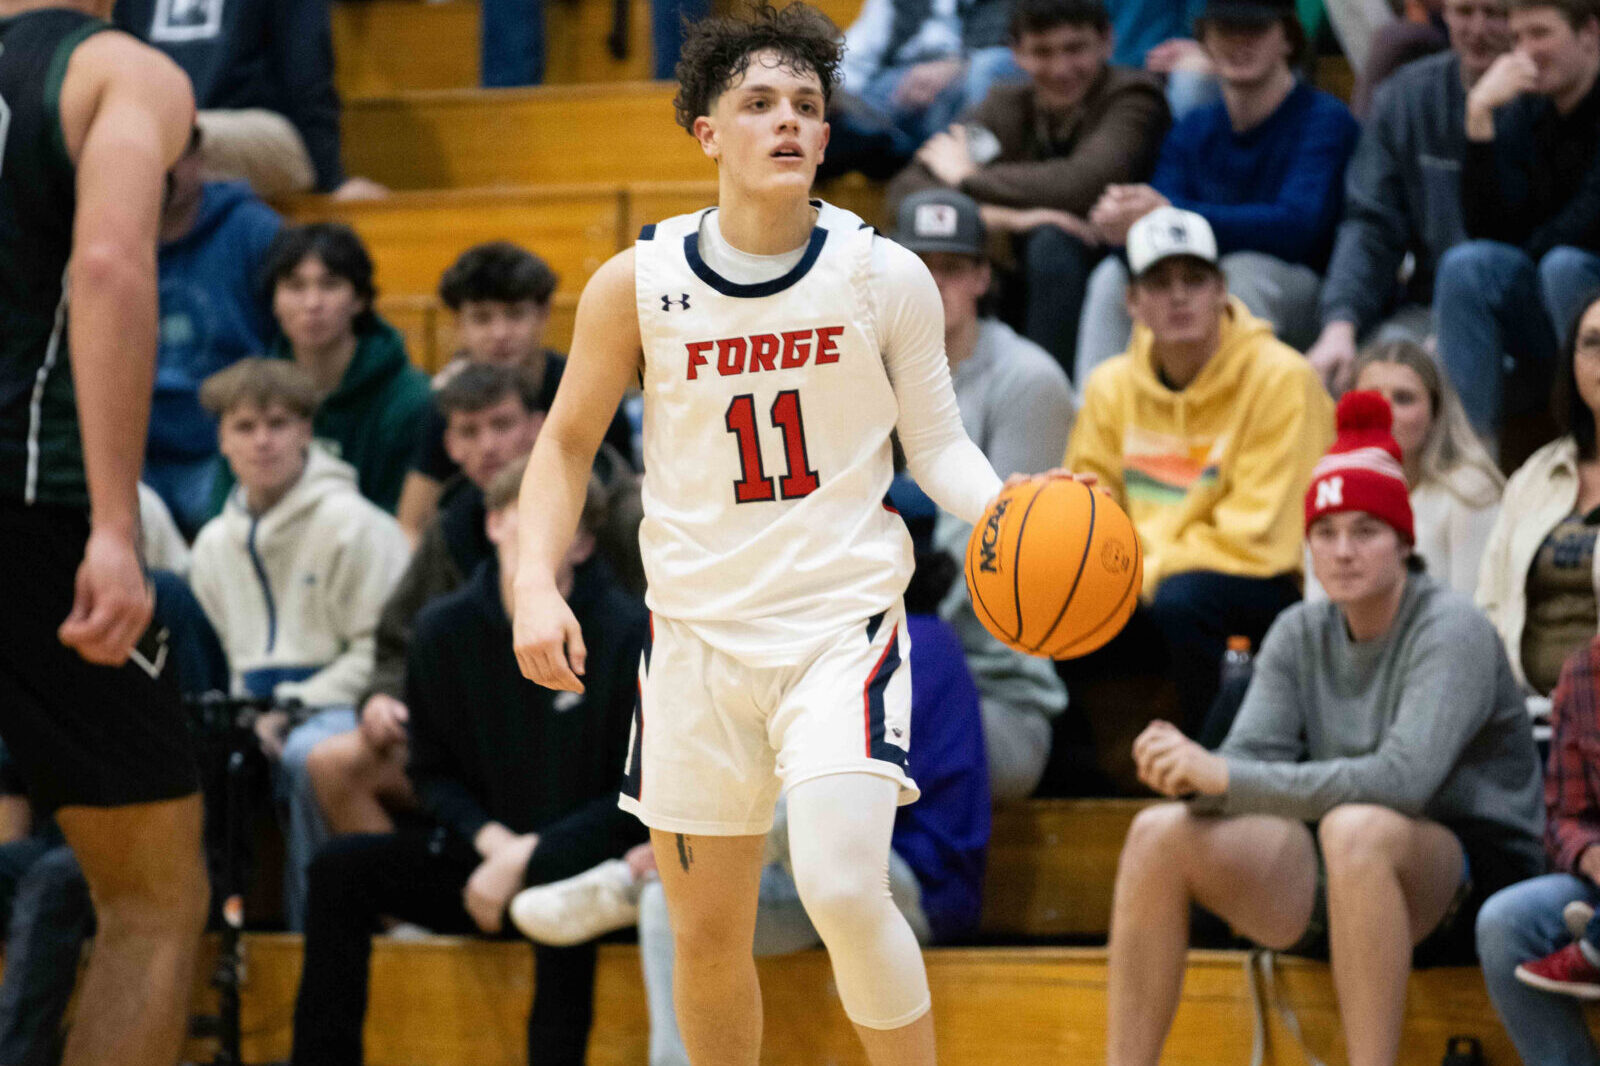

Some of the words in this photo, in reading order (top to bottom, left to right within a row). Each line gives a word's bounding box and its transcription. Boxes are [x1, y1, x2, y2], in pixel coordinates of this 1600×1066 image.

[685, 326, 845, 380] FORGE
[725, 389, 821, 504] 11
[1316, 476, 1344, 510] N
[980, 499, 1012, 573] NCAA
